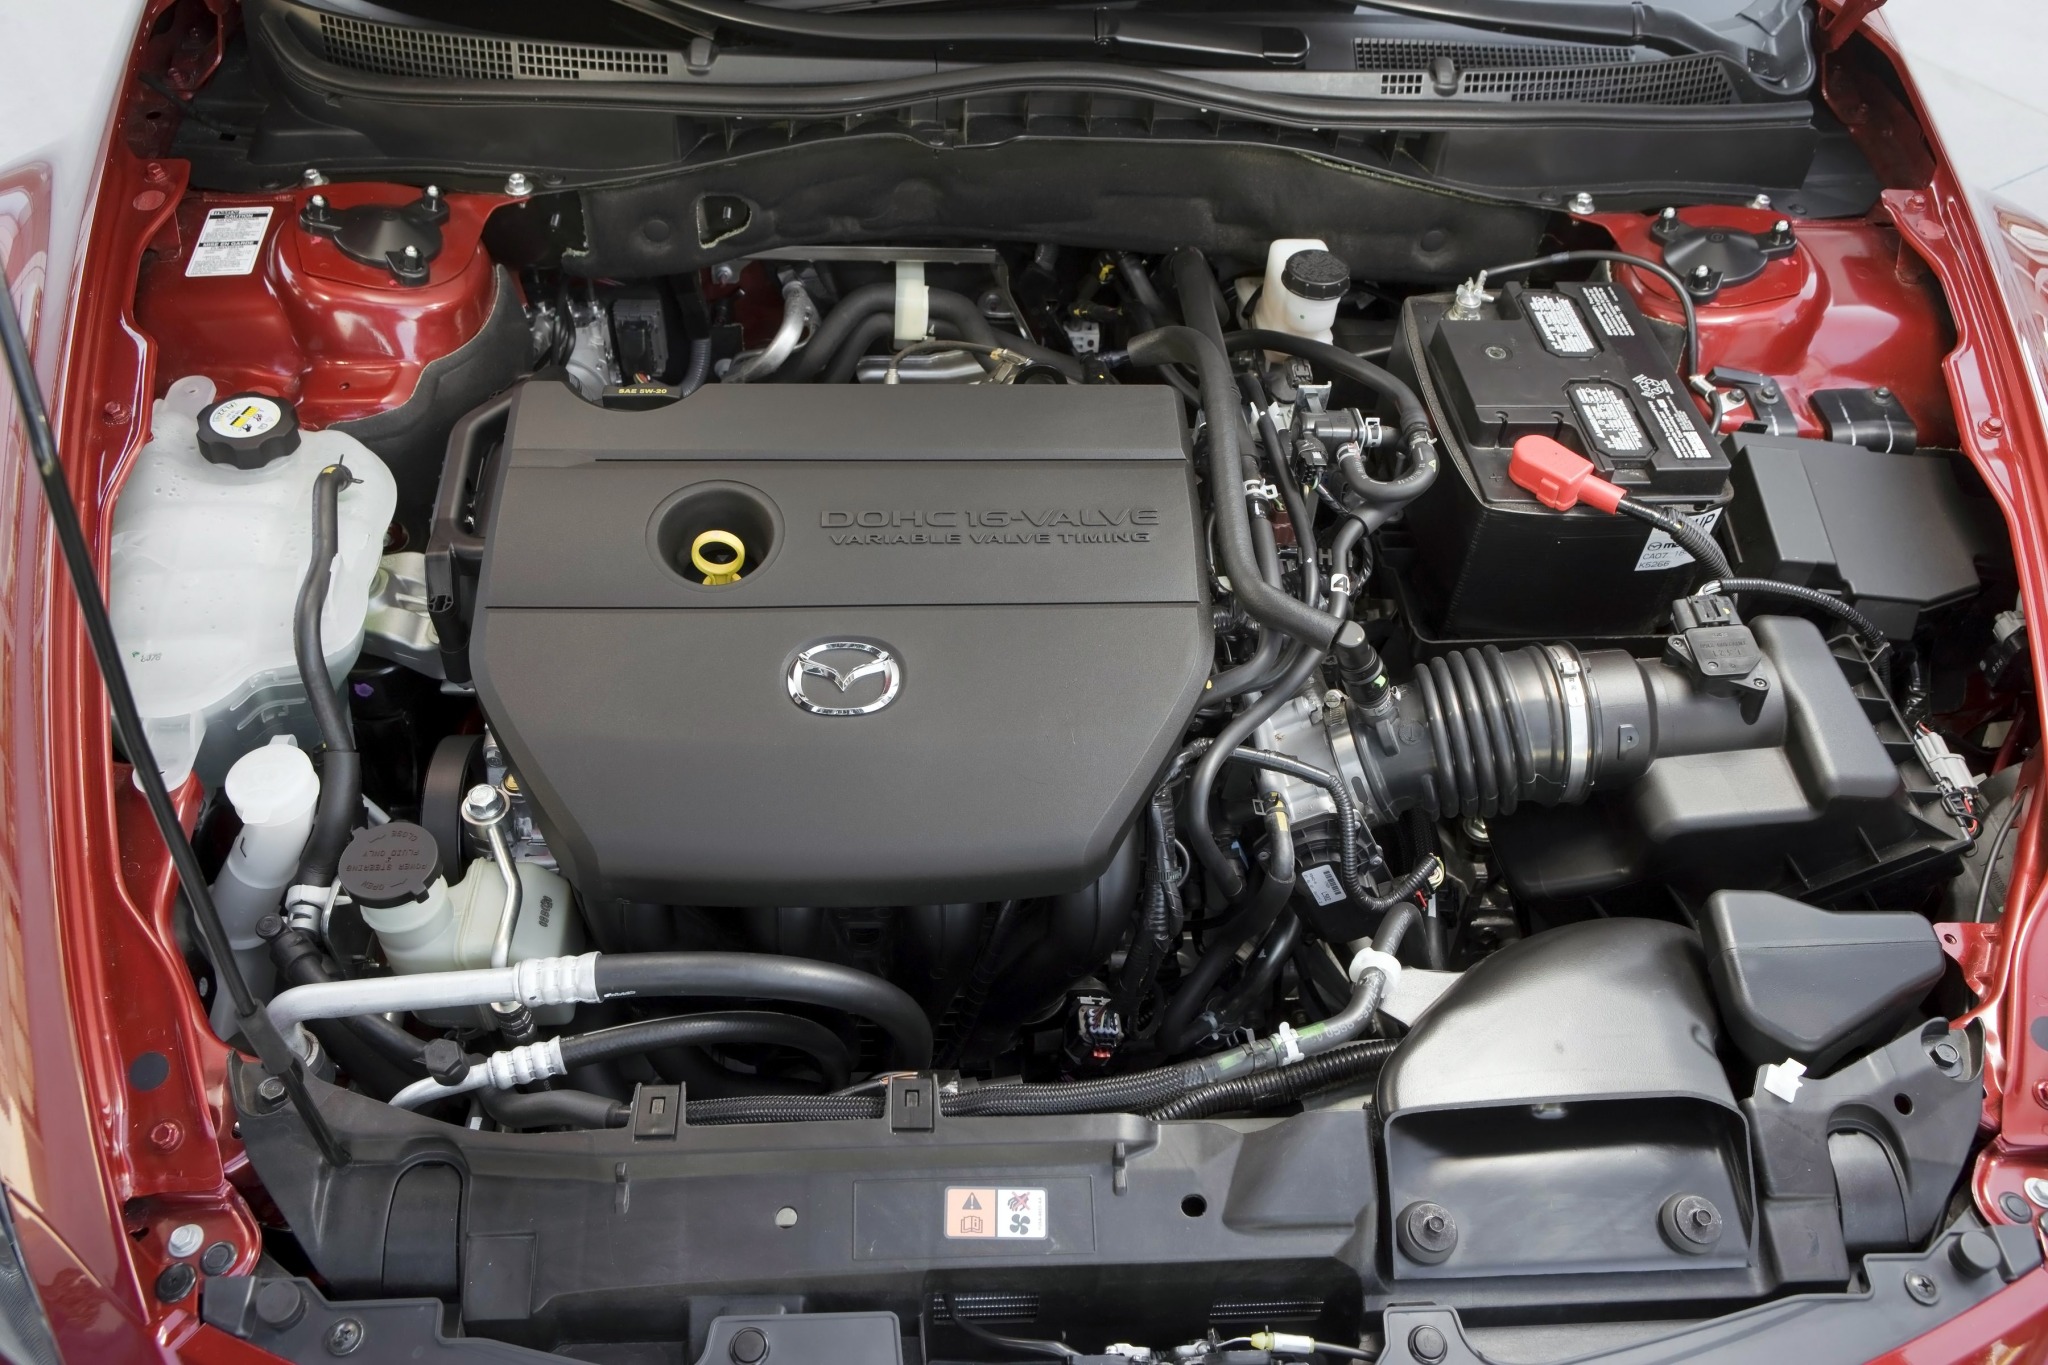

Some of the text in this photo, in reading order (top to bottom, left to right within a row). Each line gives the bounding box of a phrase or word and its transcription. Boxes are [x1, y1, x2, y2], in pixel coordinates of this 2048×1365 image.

[820, 508, 1160, 529] DOHC 16-VALVE
[830, 531, 1151, 545] VARIABLE VALVE TIMING
[1333, 576, 1348, 592] 4
[391, 830, 418, 842] CLOSE
[391, 849, 420, 857] FLUID
[346, 863, 427, 872] POWER STEERING
[361, 880, 385, 891] OPEN
